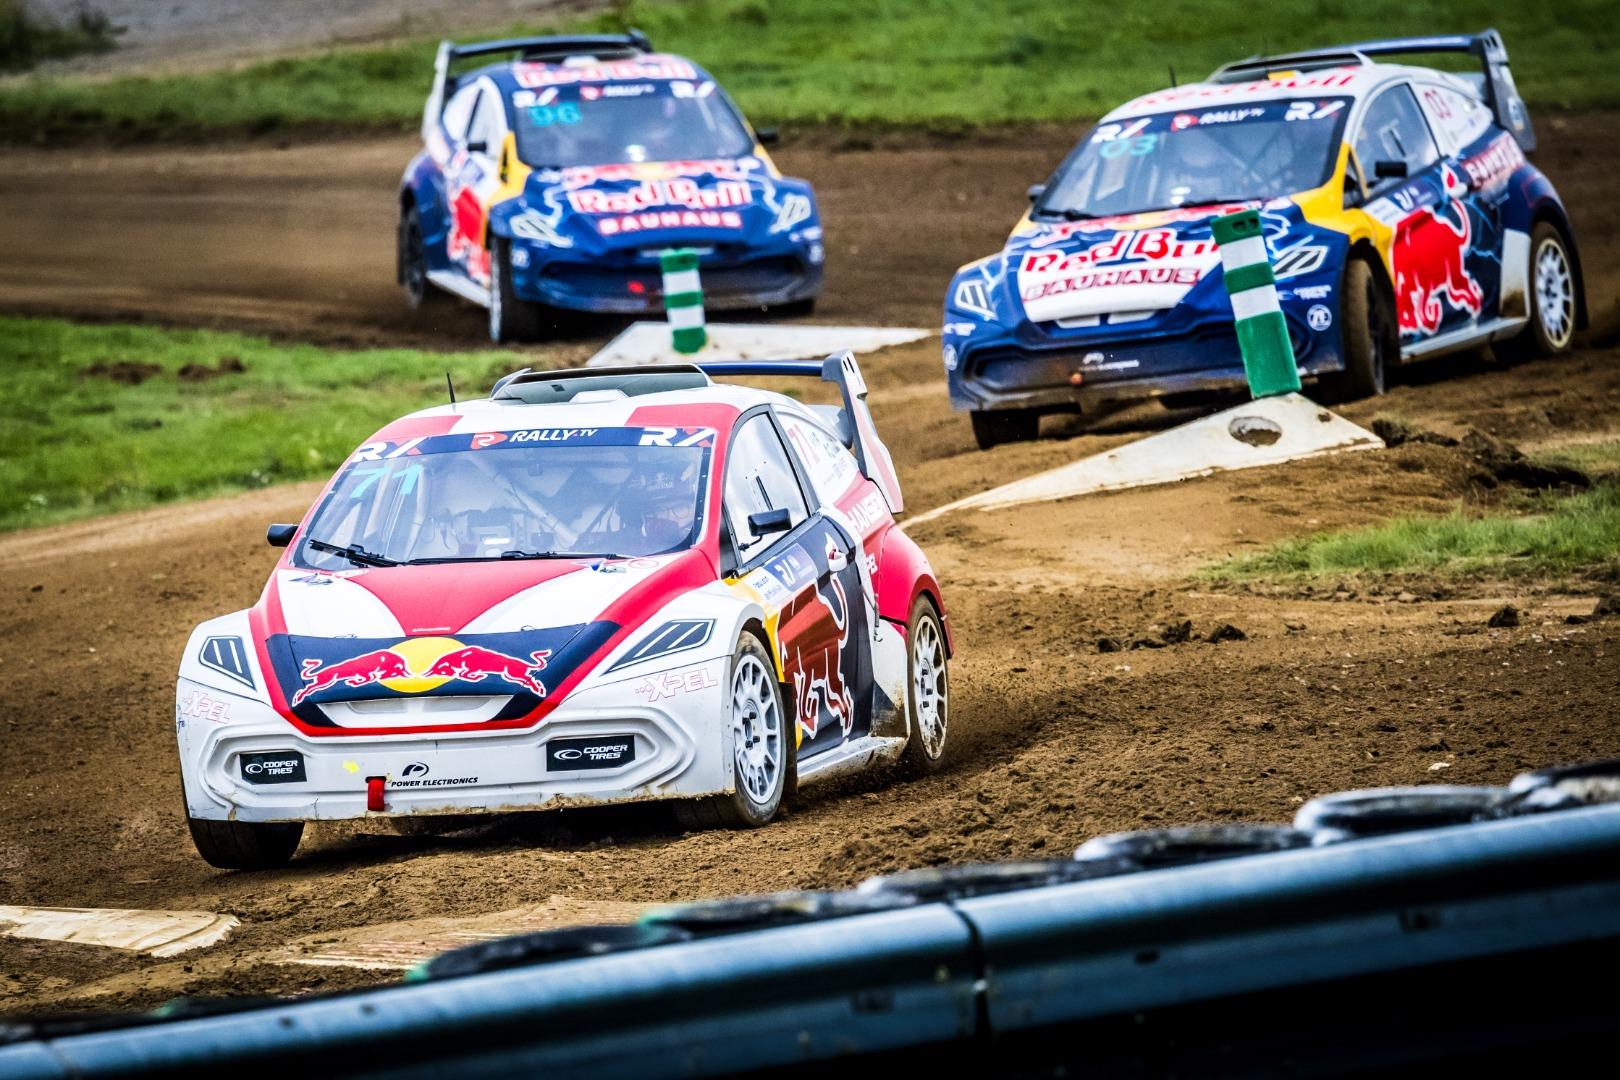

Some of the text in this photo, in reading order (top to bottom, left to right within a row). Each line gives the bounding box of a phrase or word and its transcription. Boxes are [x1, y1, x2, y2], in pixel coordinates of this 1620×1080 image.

[528, 101, 581, 126] 96
[567, 180, 664, 214] Red
[599, 211, 741, 235] BAUHAUS
[1024, 230, 1221, 273] Red Bu
[1024, 267, 1200, 301] BAUHAUS
[350, 463, 423, 500] 71
[583, 744, 628, 754] COOPER
[589, 751, 622, 761] TIRES
[263, 760, 298, 769] COOPER
[267, 766, 293, 776] TIRES
[391, 776, 479, 788] POWER ELECTRONICS
